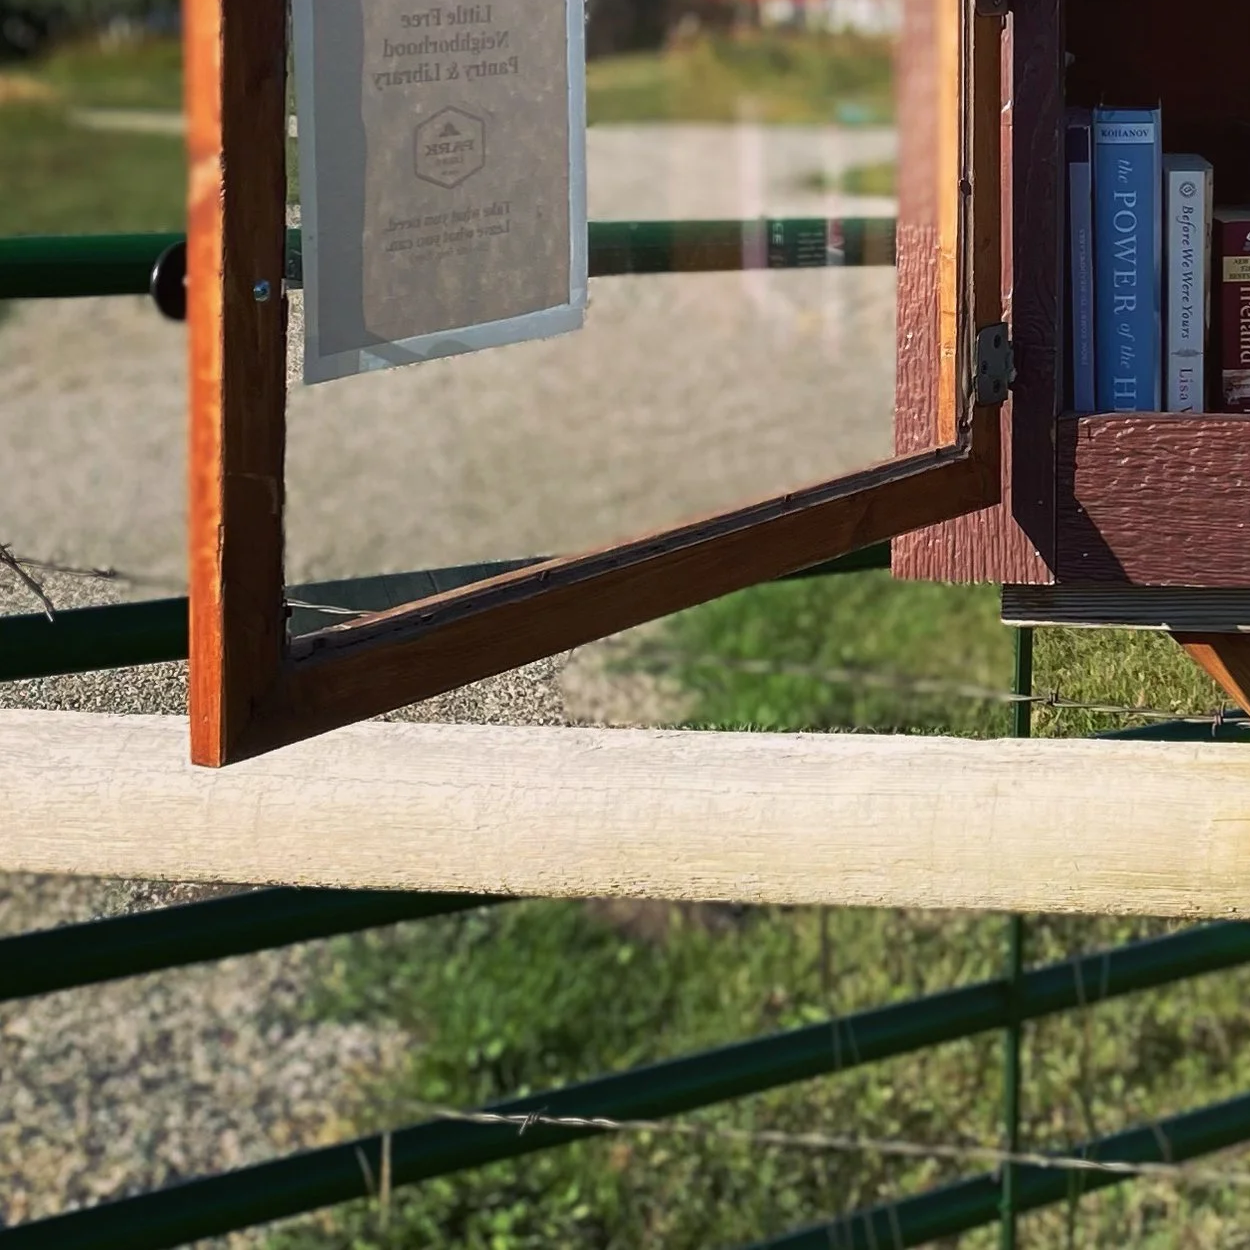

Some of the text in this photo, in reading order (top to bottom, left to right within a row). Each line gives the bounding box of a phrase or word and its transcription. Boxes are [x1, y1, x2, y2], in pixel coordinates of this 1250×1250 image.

[1100, 128, 1149, 138] KOHANOV
[1118, 159, 1133, 183] the
[1113, 190, 1138, 315] POWER
[1175, 205, 1195, 339] Before We Were Yours
[1118, 323, 1135, 342] of
[1119, 345, 1135, 369] the
[1180, 368, 1194, 400] Lisa
